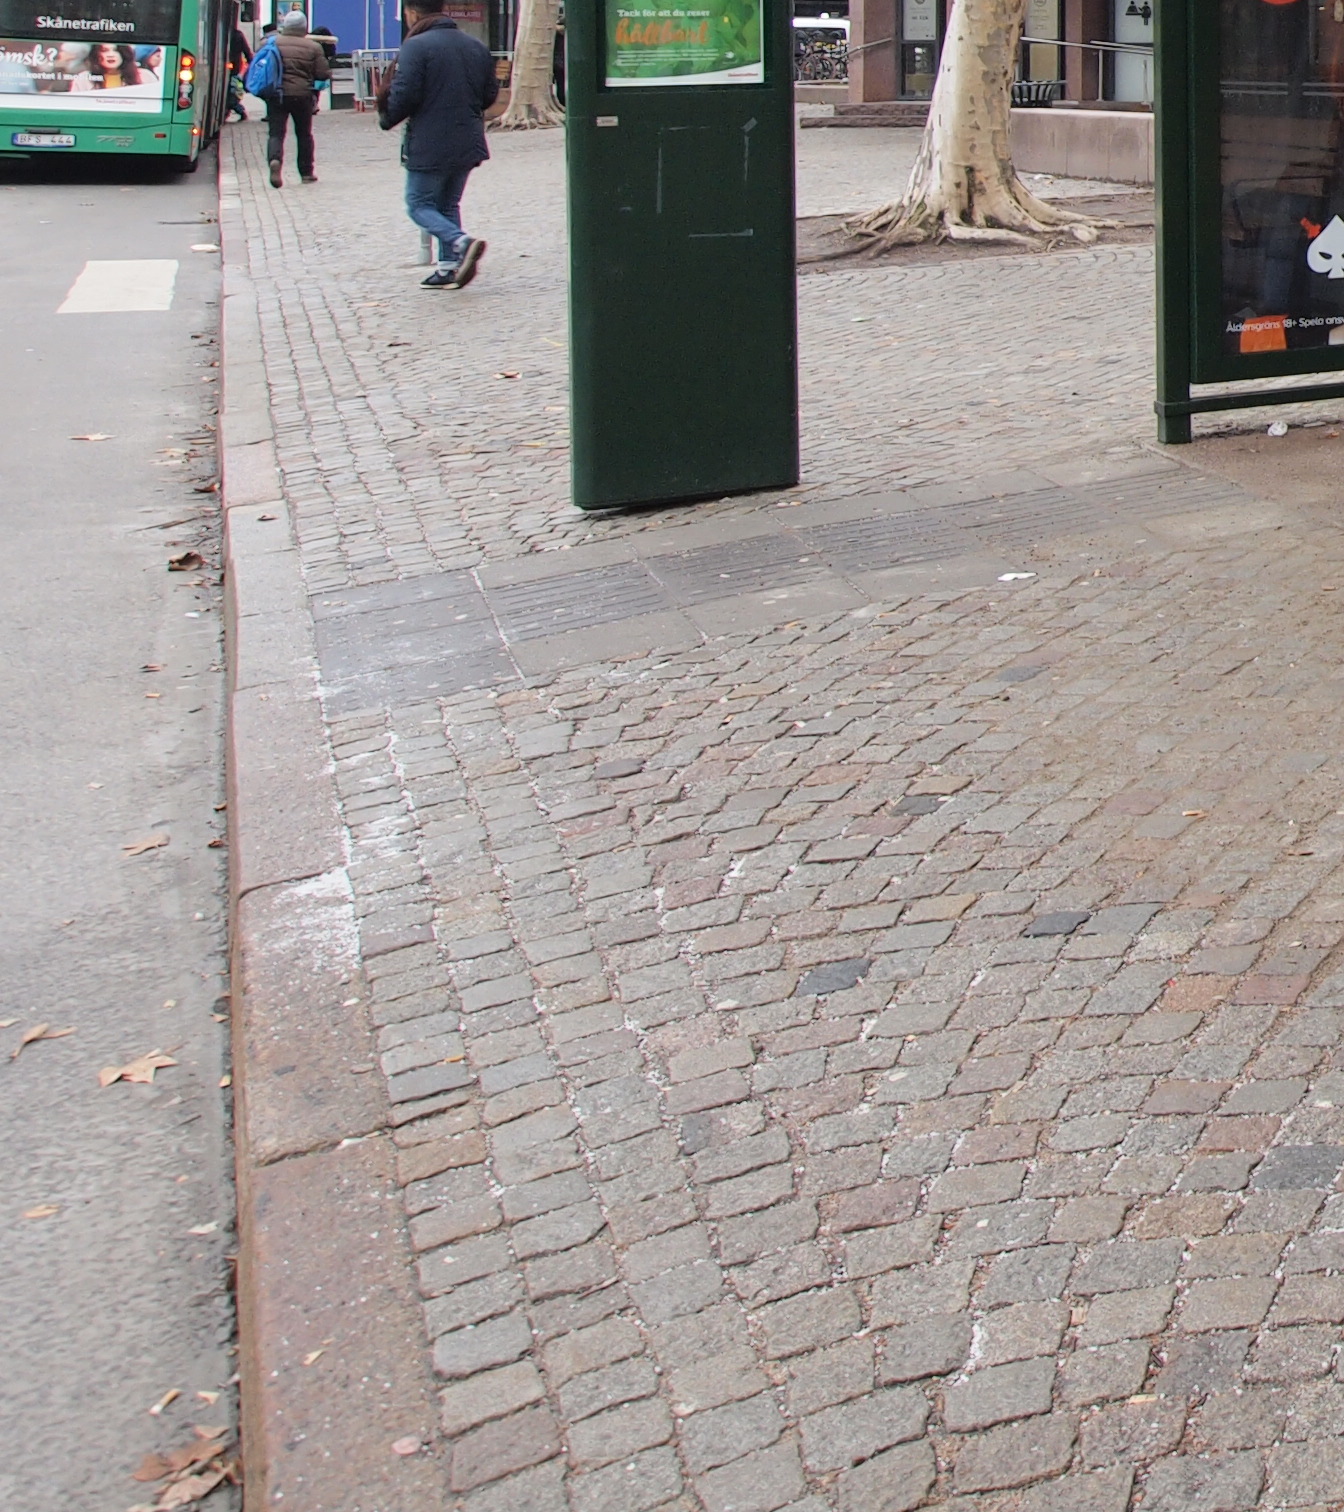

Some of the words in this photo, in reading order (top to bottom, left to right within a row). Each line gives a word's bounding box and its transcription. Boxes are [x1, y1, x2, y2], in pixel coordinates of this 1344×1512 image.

[616, 9, 640, 17] Tack
[642, 8, 656, 17] för
[658, 9, 671, 17] att
[673, 9, 685, 17] du
[687, 9, 710, 17] reser
[37, 15, 135, 32] Skånetrafiken
[1225, 320, 1280, 334] Åldersgräns
[1299, 317, 1325, 329] Spela
